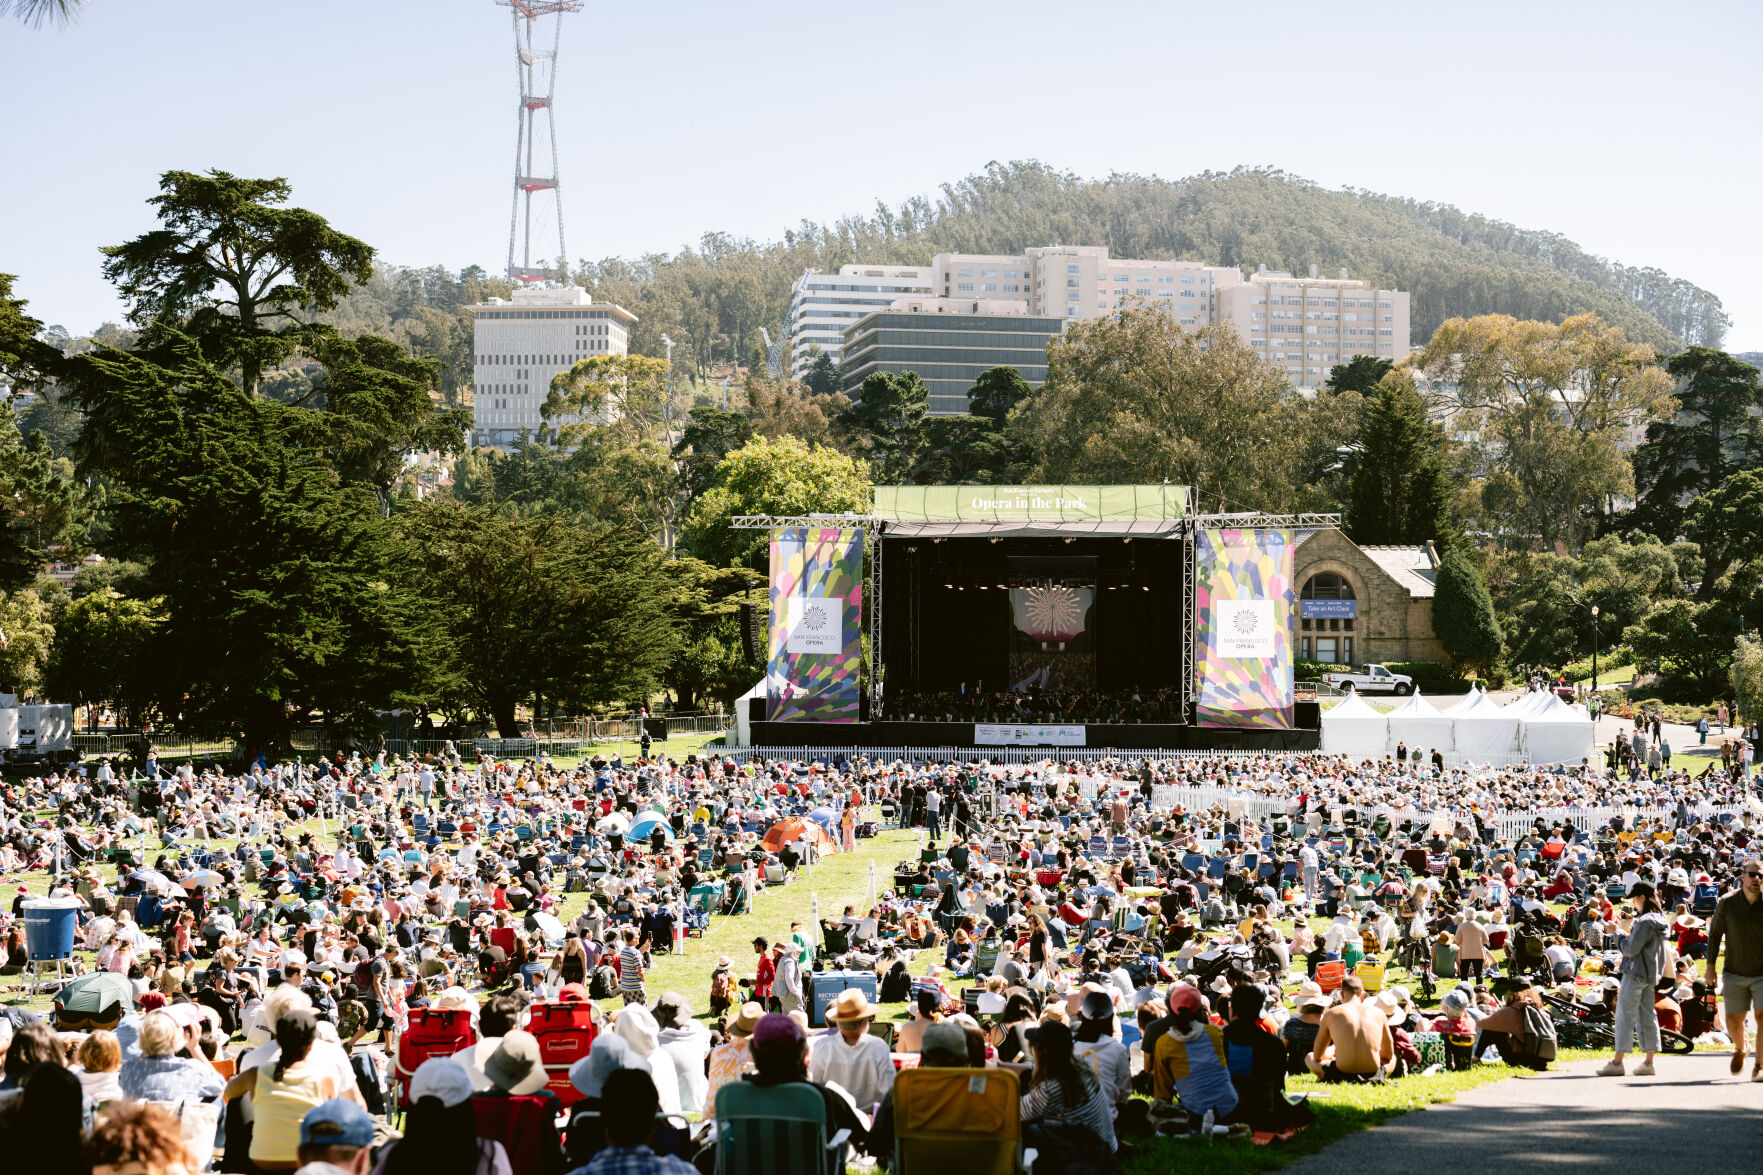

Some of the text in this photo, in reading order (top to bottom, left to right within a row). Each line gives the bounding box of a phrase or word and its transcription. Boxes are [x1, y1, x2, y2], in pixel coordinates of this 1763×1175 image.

[971, 496, 1087, 510] Opera in the Park
